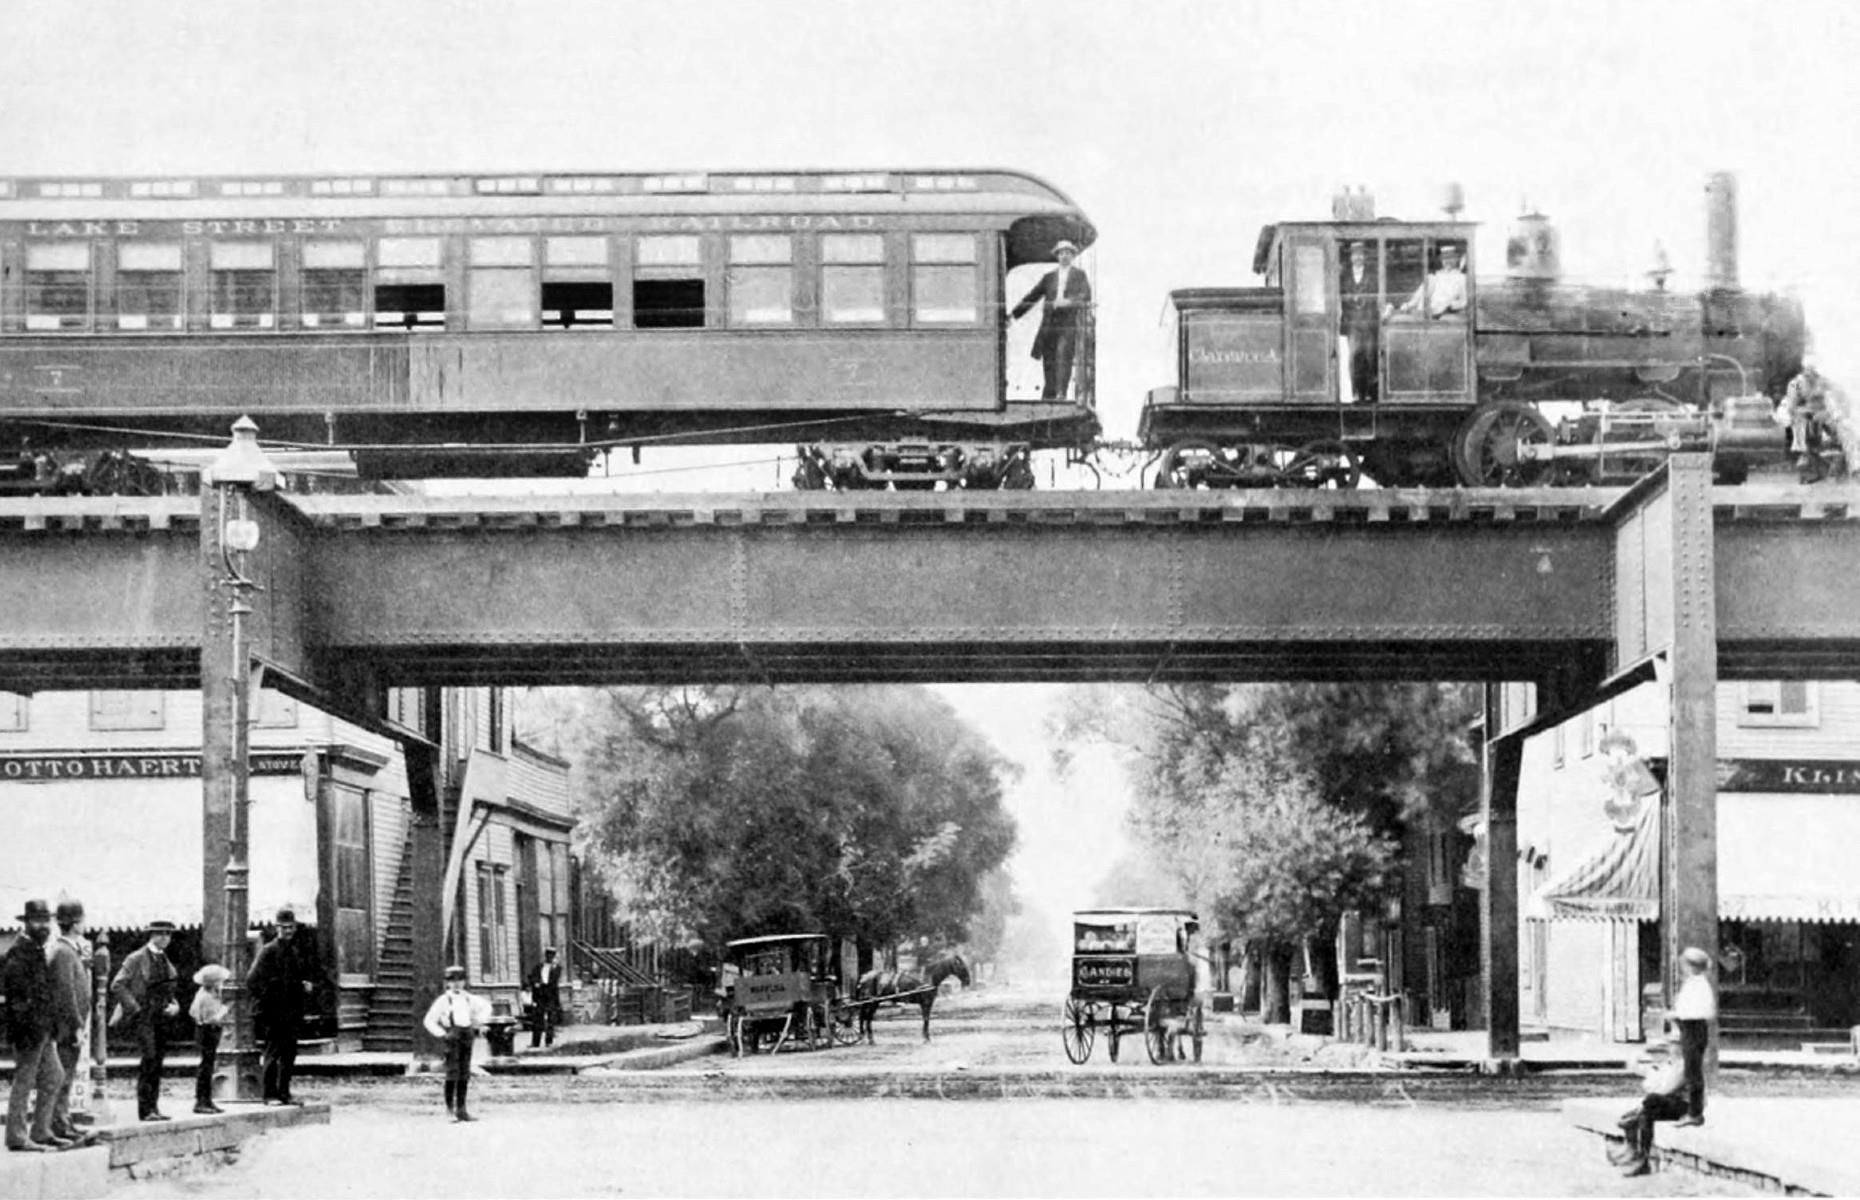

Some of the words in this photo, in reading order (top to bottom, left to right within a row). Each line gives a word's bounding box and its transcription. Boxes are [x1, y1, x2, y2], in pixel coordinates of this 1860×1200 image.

[27, 221, 140, 236] LAKE
[181, 219, 343, 235] STREET
[4, 758, 84, 777] OTTO
